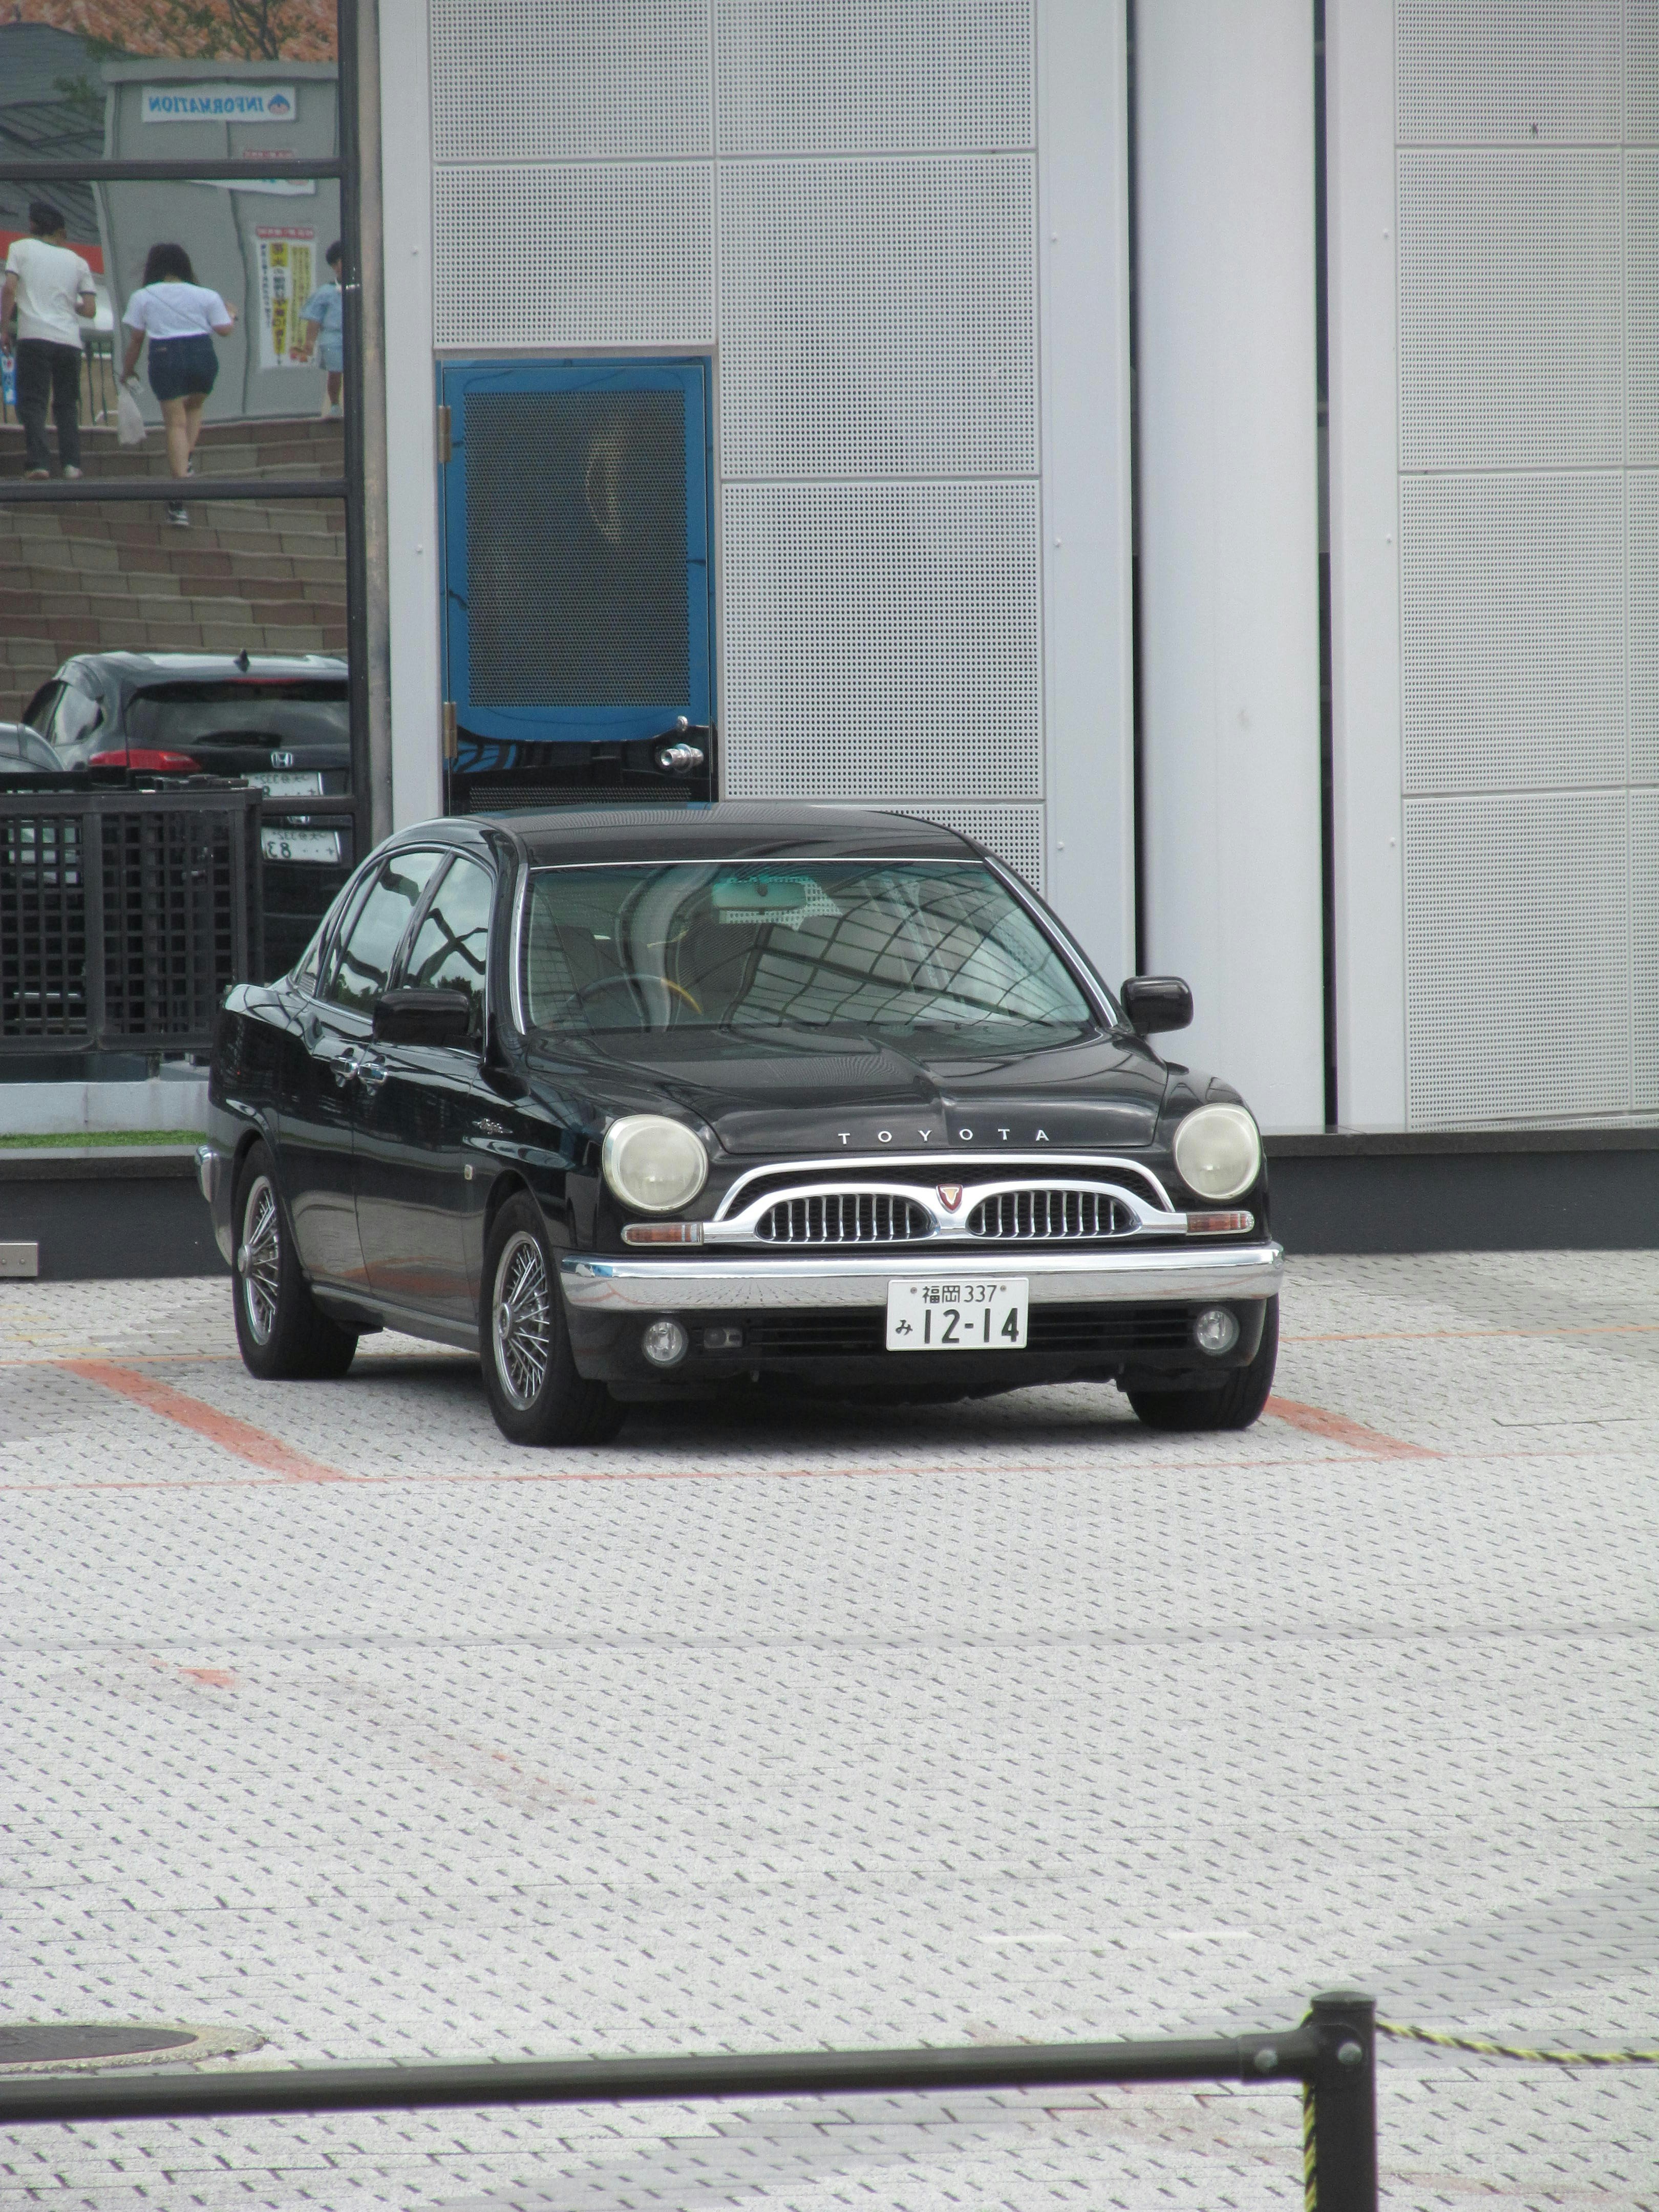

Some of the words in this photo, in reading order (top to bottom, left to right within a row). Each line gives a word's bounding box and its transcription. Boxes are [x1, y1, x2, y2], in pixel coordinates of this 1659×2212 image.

[838, 1129, 1050, 1145] TOYOTA
[895, 1319, 913, 1335] み
[924, 1307, 1019, 1344] 12-14
